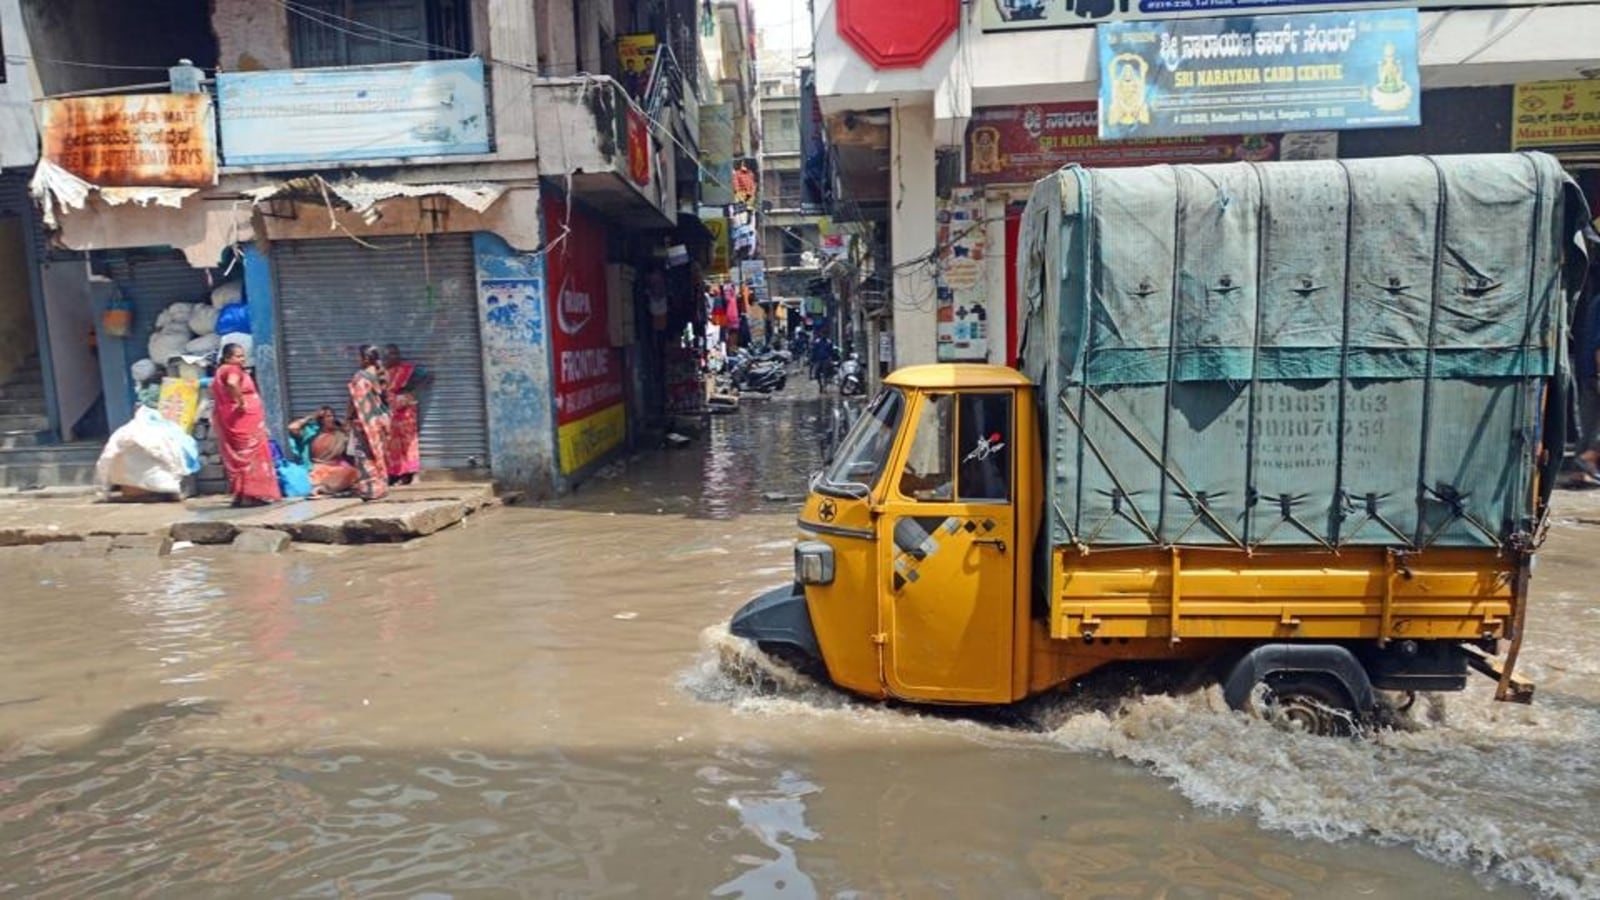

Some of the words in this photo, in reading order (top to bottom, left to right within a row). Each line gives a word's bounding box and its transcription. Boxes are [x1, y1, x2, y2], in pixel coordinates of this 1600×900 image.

[1174, 70, 1194, 87] SRI
[1197, 68, 1260, 86] NARAYANA
[1263, 66, 1295, 83] CARD
[1297, 64, 1343, 81] CENTRE
[1040, 135, 1058, 148] SRI
[561, 348, 609, 383] FRONTLINE
